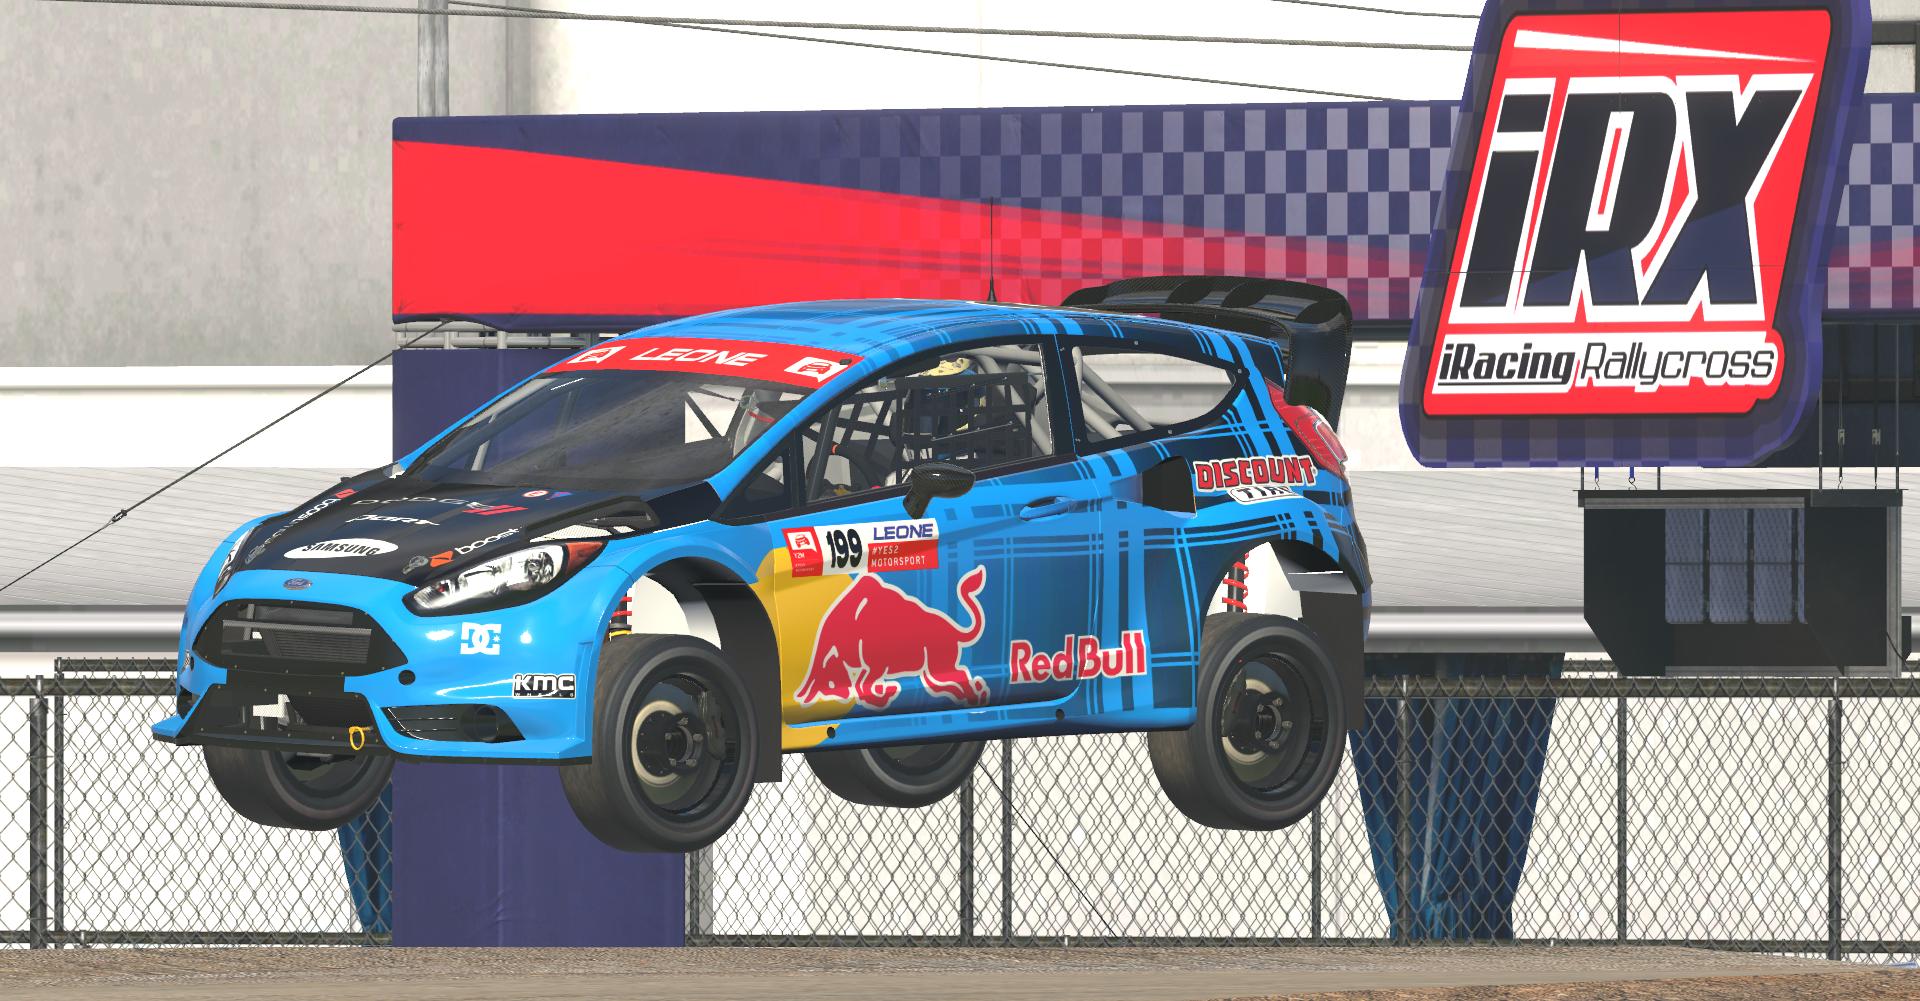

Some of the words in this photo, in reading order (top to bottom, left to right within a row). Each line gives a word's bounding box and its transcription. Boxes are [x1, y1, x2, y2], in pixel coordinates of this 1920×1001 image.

[1455, 80, 1809, 316] iRX
[629, 347, 769, 367] LEONE
[1439, 342, 1576, 385] iRacing
[1581, 341, 1775, 385] Rallycross
[1195, 456, 1315, 490] DISCOUNT
[826, 528, 863, 569] 199
[873, 523, 934, 541] LEONE
[302, 543, 380, 556] SAMSUNG
[871, 555, 926, 568] MOTORSPORT
[460, 622, 501, 655] DC
[1011, 635, 1074, 684] Red
[1077, 630, 1147, 680] Bull
